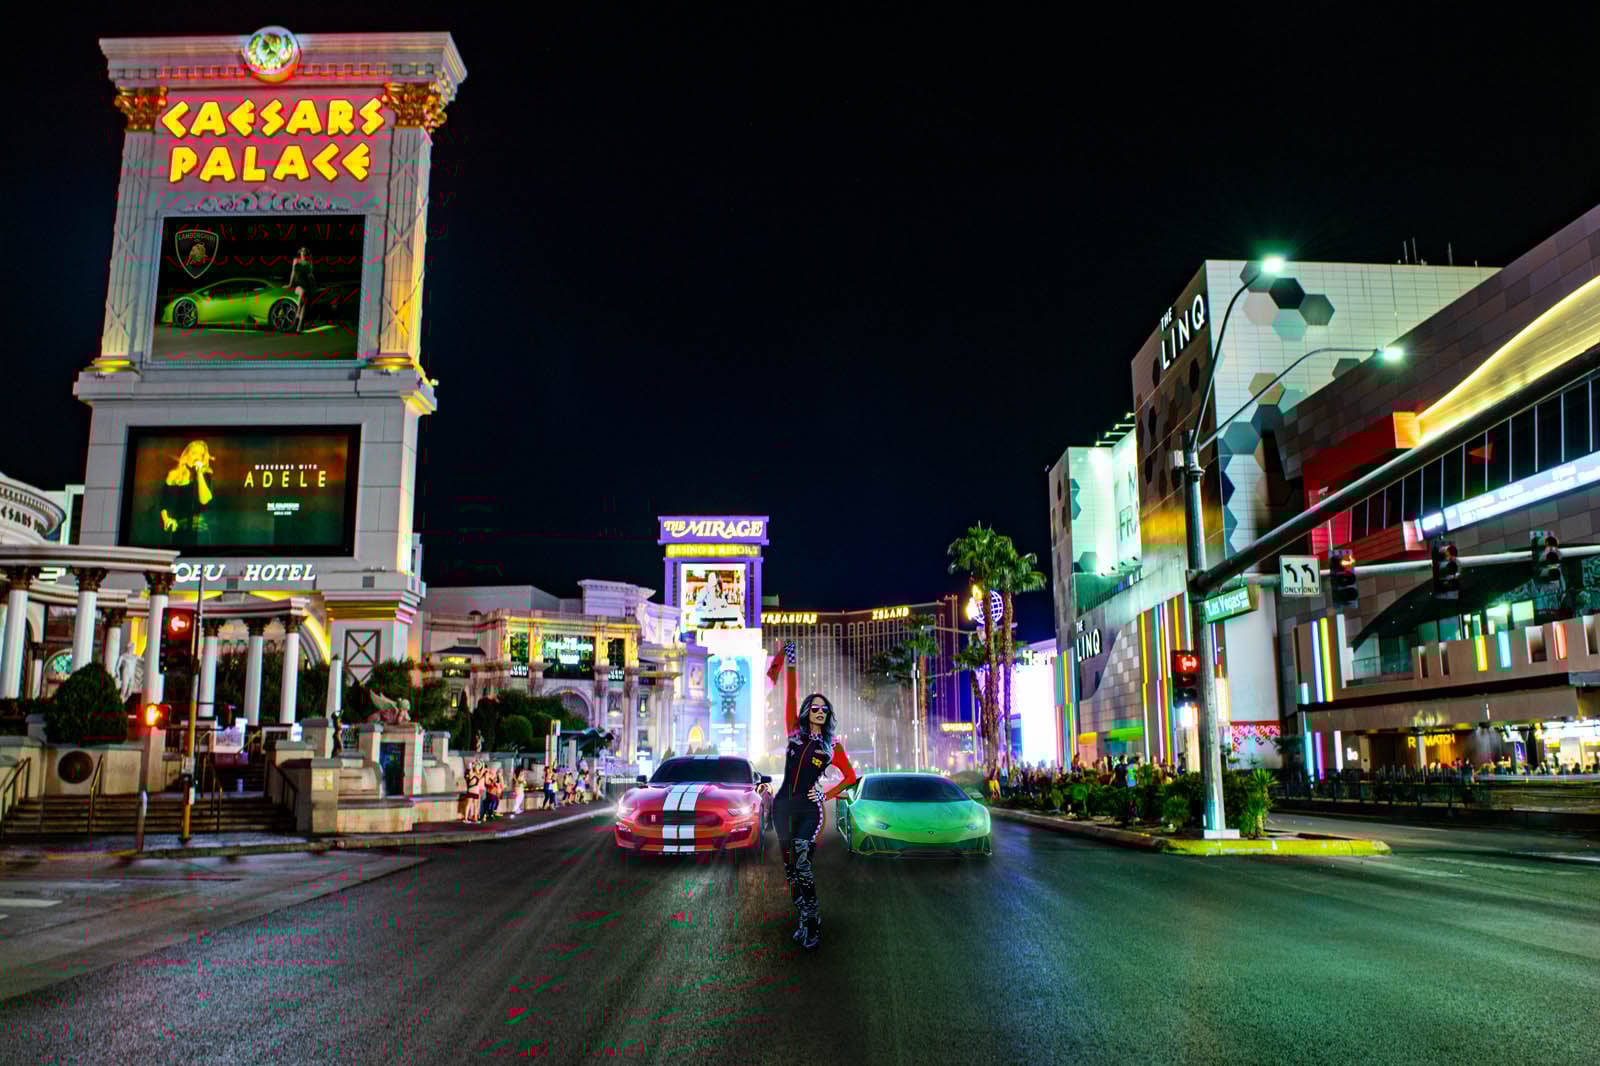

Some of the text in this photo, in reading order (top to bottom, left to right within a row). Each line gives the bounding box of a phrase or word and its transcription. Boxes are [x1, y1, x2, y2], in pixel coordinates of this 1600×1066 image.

[160, 98, 385, 138] CAESARS
[169, 143, 371, 183] PALACE
[1161, 306, 1173, 332] THE
[1161, 294, 1205, 370] LINQ
[244, 470, 327, 488] ADELE
[663, 520, 686, 532] THE
[673, 520, 764, 539] MIRAGE
[171, 562, 316, 583] OBU HOTEL
[1284, 586, 1319, 594] ONLY ONLY
[1218, 593, 1242, 614] Vegas
[760, 606, 909, 624] TREASURE ISLAND
[1076, 628, 1100, 662] LINQ
[1407, 733, 1456, 748] RMATCH
